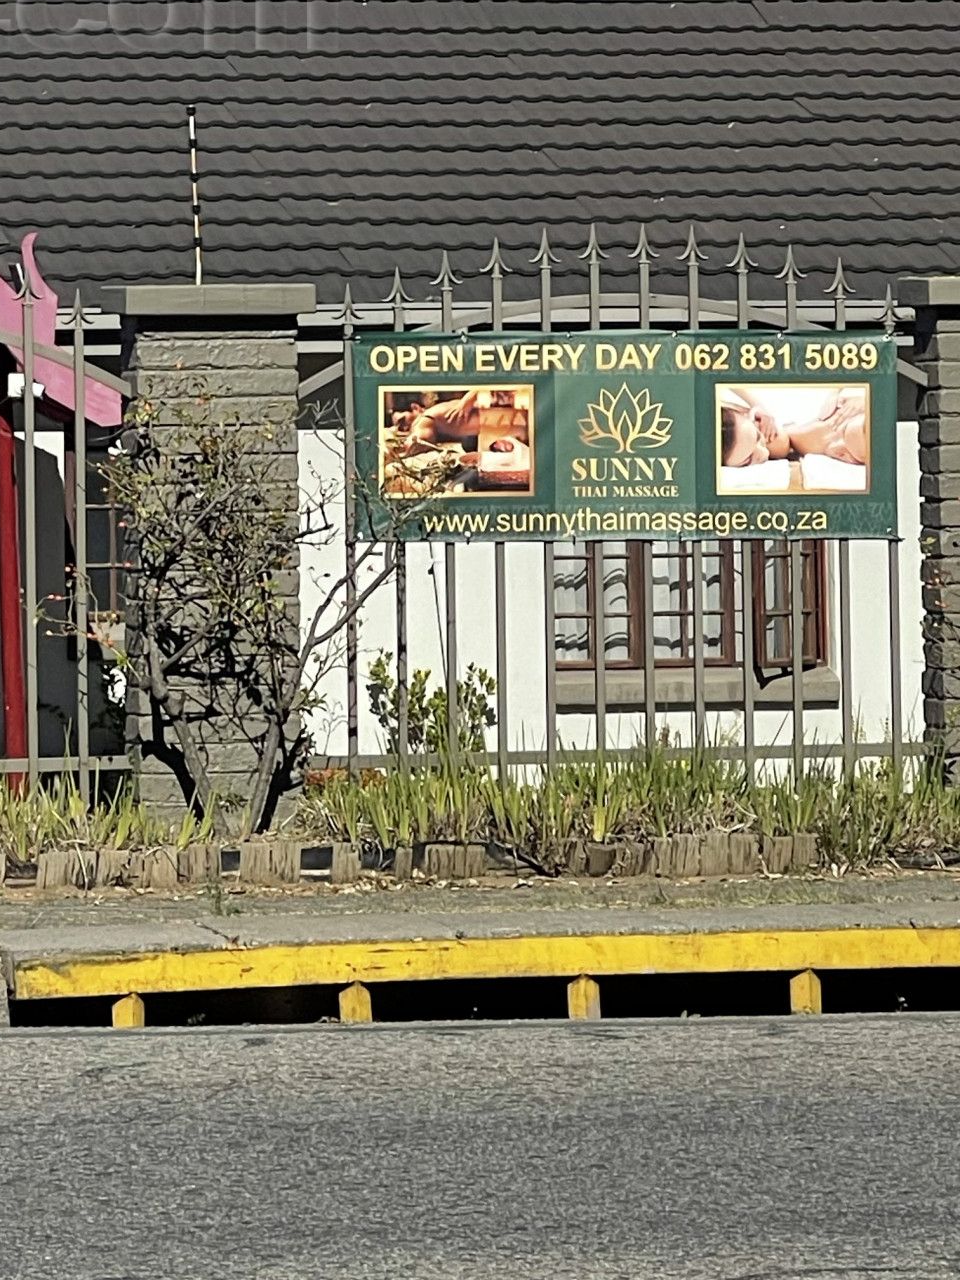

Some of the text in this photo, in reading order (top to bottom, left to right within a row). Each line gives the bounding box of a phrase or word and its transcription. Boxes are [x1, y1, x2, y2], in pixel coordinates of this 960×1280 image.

[369, 343, 879, 373] OPEN EVERY DAY 062 831 5089
[571, 457, 679, 483] SUNNY
[571, 485, 680, 498] THAI MASSAGE
[424, 507, 828, 539] www.sunnythaimassage.co.za
